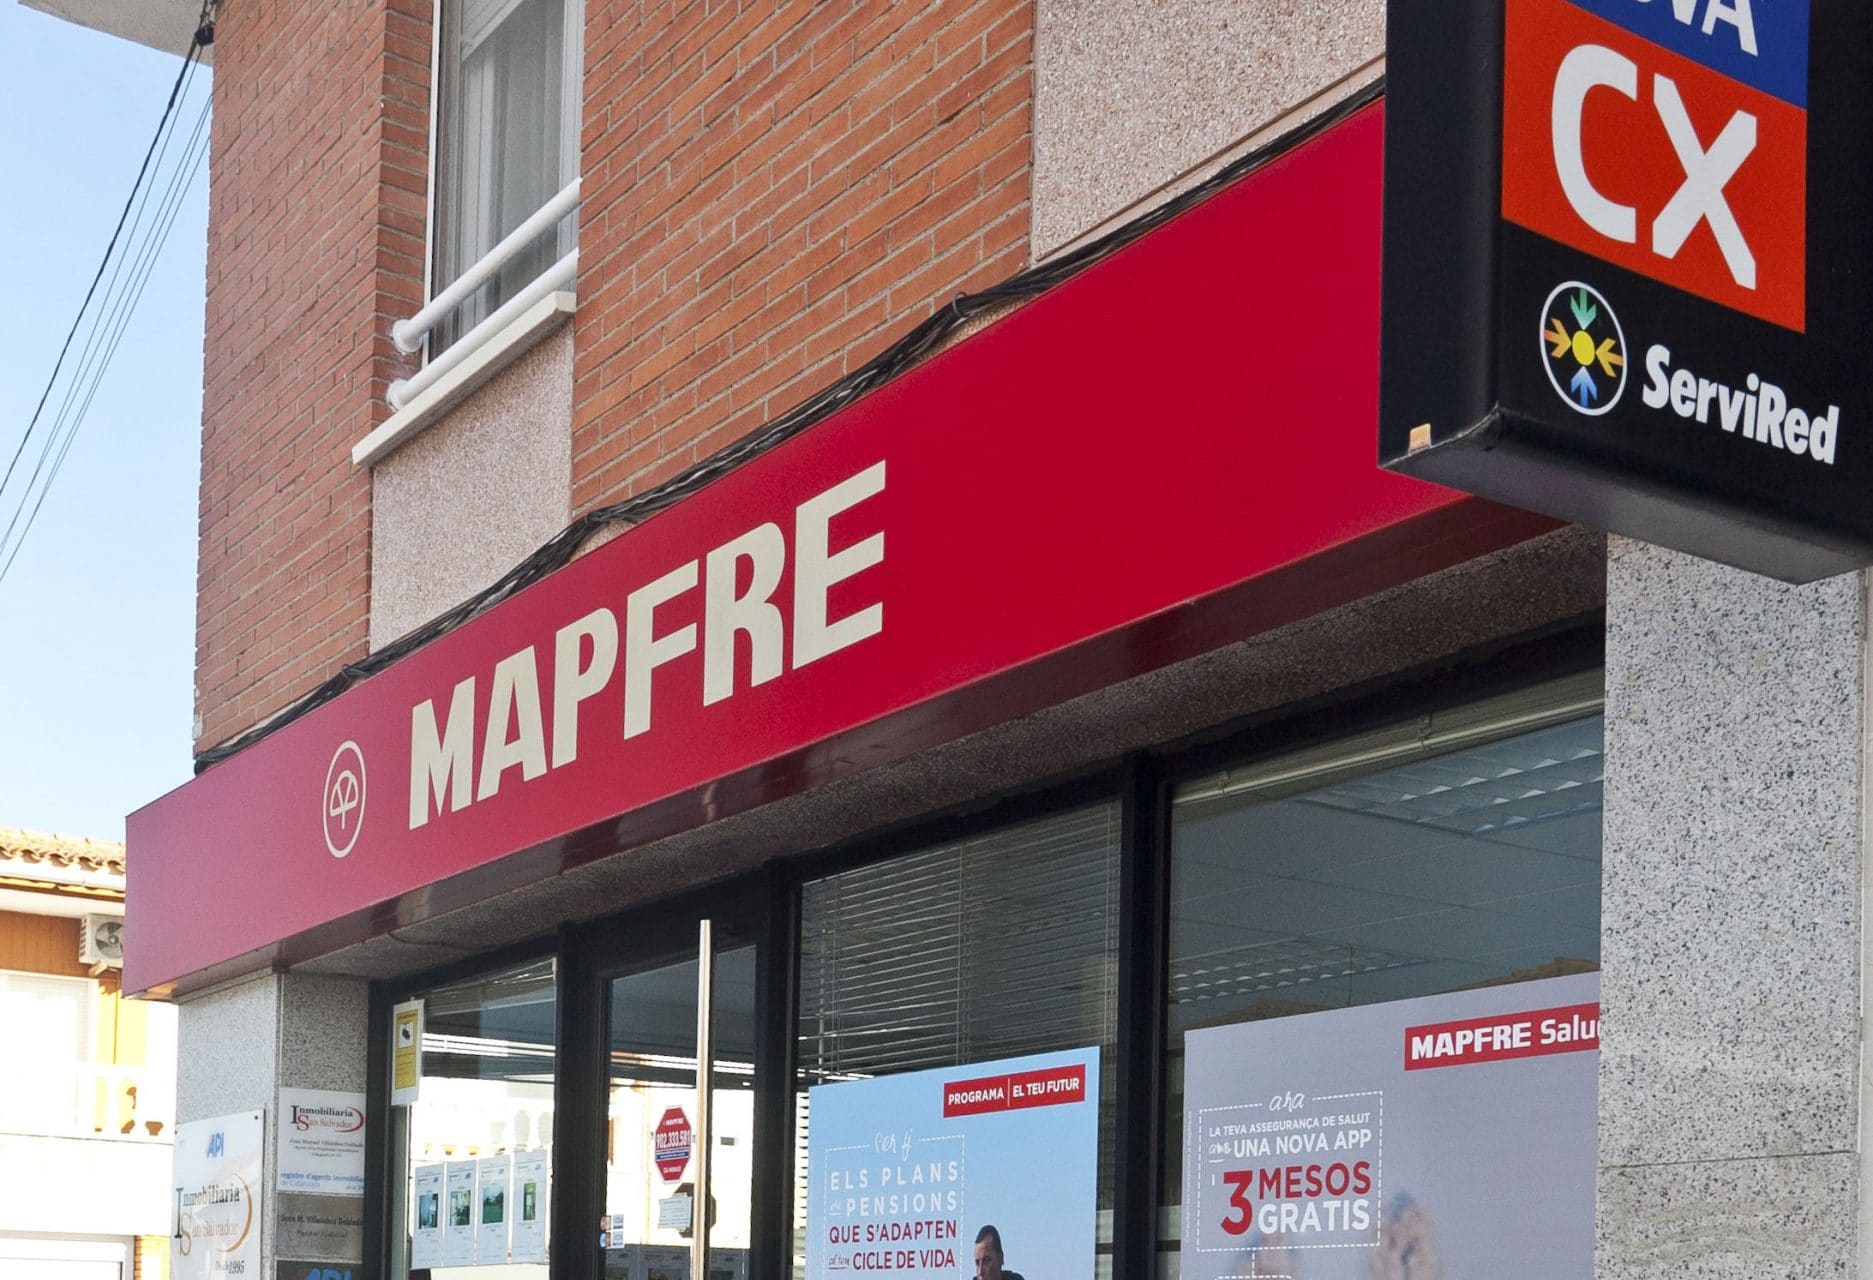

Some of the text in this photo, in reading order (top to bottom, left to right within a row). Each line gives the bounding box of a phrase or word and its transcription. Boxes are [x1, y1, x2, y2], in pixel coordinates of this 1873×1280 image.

[1551, 43, 1757, 291] CX
[1642, 344, 1840, 465] ServiRed
[408, 459, 886, 831] MAPFRE
[1411, 1014, 1600, 1060] MAPFRE Salu
[948, 1077, 1080, 1105] PROGRAMA EL TEU FUTUR
[1269, 1090, 1305, 1112] ara
[290, 1105, 353, 1124] Inmobiliaria
[1209, 1112, 1371, 1138] LA TEVA ASSEGURANÇA DE SALUT
[1233, 1137, 1271, 1158] UNA
[1276, 1132, 1330, 1155] NOVA
[1333, 1128, 1372, 1150] APP
[831, 1161, 958, 1191] ELS PLANS
[175, 1183, 240, 1239] Inmobiliaria
[846, 1190, 957, 1217] PENSIONS
[1220, 1169, 1253, 1236] 3
[1259, 1160, 1372, 1200] MESOS
[1258, 1199, 1371, 1235] GRATIS
[829, 1225, 860, 1243] QUE
[852, 1251, 892, 1270] CICLE
[896, 1250, 915, 1269] DE
[920, 1248, 956, 1269] VIDA
